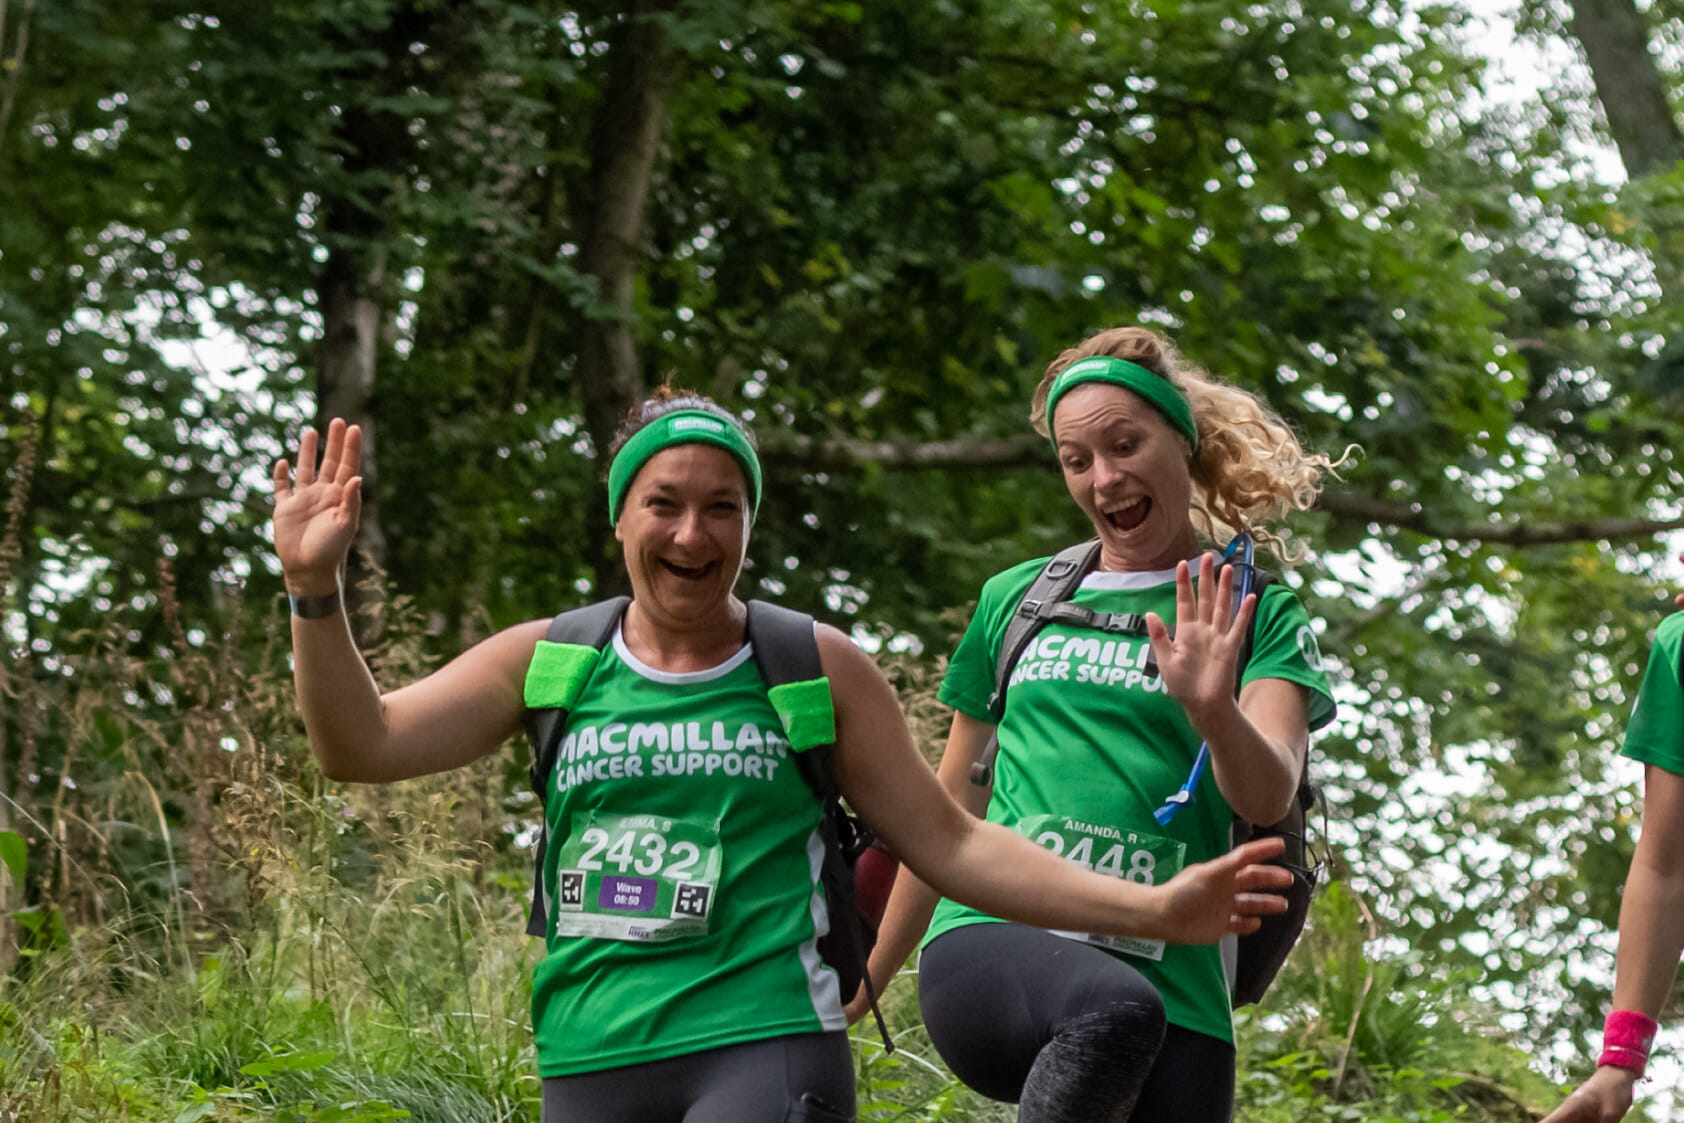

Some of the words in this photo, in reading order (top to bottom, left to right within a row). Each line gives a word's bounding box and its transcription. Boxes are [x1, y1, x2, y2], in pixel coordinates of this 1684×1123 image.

[1008, 660, 1070, 687] NCER
[1077, 663, 1169, 694] SUPPO
[557, 755, 644, 793] CANCER
[651, 752, 779, 782] SUPPORT
[576, 828, 700, 881] 2432
[1127, 833, 1138, 844] R
[616, 881, 642, 895] Wave
